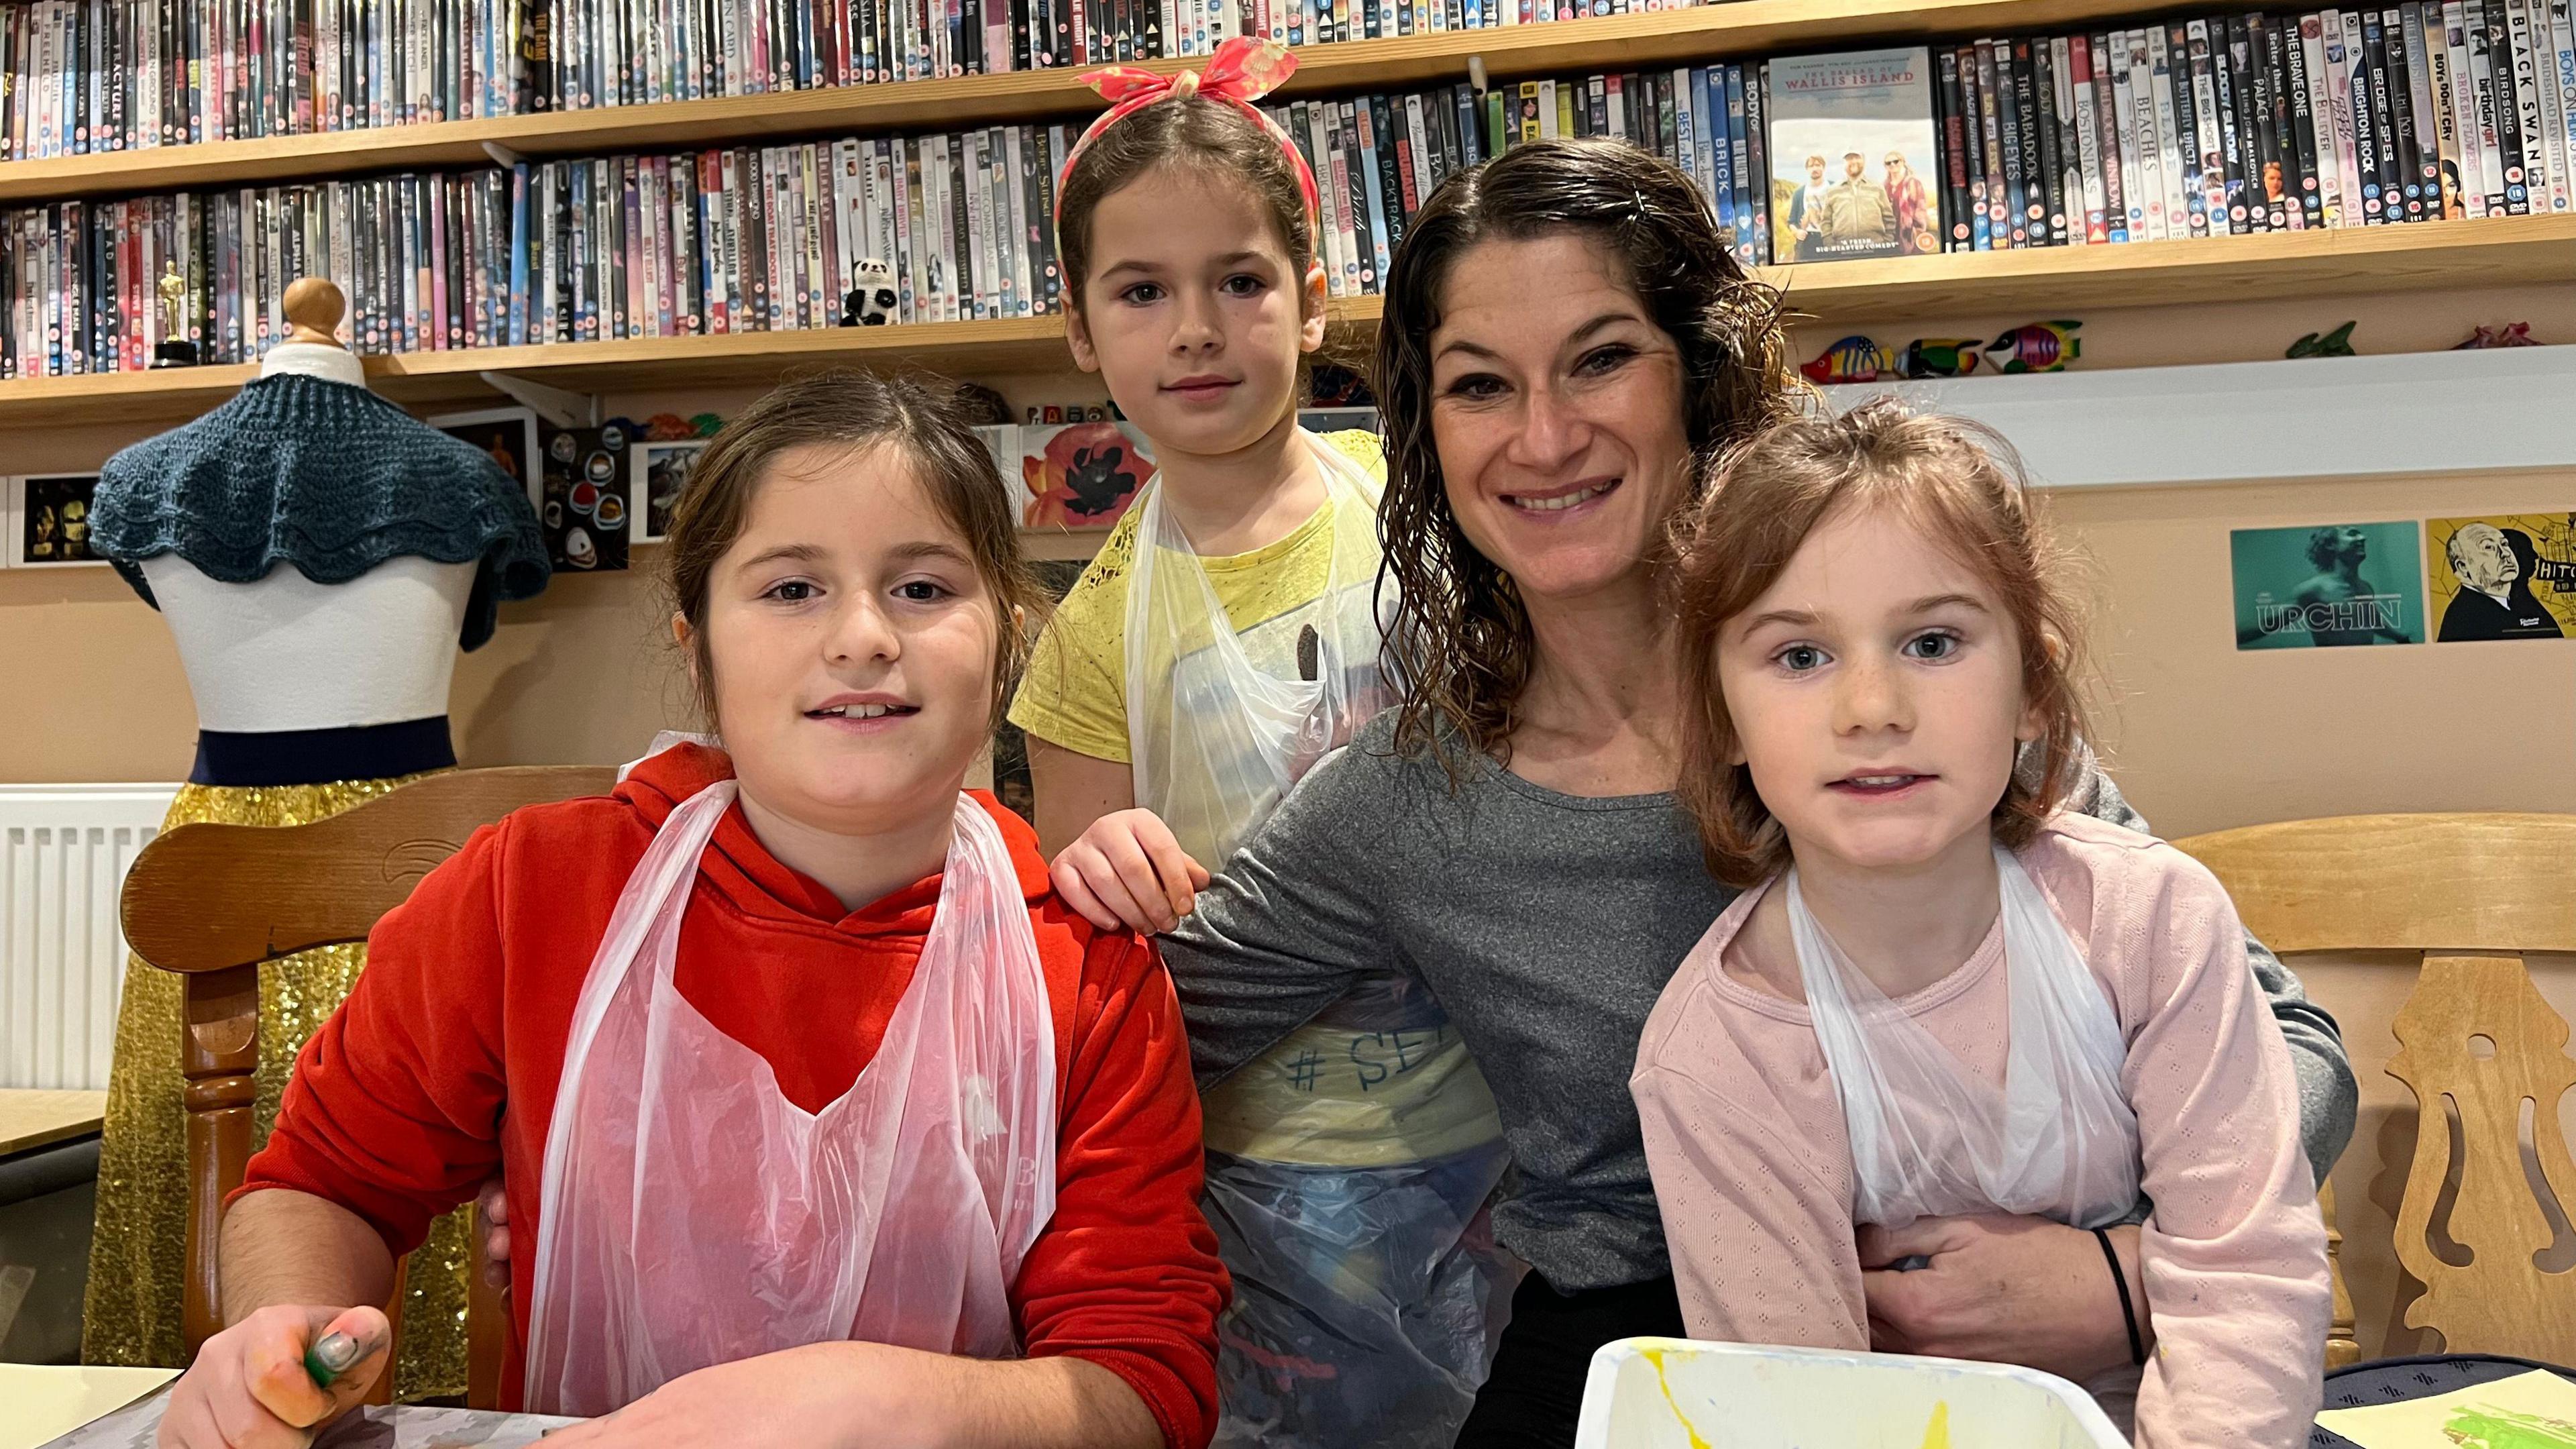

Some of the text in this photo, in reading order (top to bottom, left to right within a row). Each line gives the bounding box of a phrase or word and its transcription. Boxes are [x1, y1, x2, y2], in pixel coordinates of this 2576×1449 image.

[535, 13, 547, 60] THE GAME
[724, 20, 736, 58] CARD
[1073, 14, 1083, 46] BRIGHT
[2267, 32, 2279, 66] Better
[111, 44, 122, 119] FRACTURE
[148, 30, 157, 115] FROZEN GROUND
[1784, 72, 1915, 90] WALLIS ISLAND
[1830, 66, 1874, 76] BALLAD
[2272, 68, 2283, 93] than
[2286, 25, 2308, 118] THE BRAVE ONE
[2512, 16, 2542, 161] BLACK SWAN
[2558, 50, 2575, 85] BOYS
[1677, 111, 1691, 142] BEST
[1746, 80, 1760, 119] BODY
[1965, 84, 1980, 160] BLADE RUNNER
[2017, 74, 2038, 180] THE BABADOOK
[2038, 81, 2053, 115] BODY
[2178, 81, 2192, 127] BUTTERFLY
[2198, 77, 2214, 150] THE BIG SHORT
[2215, 54, 2238, 164] BLOODY SUNDAY
[2253, 78, 2269, 123] PALACE
[2312, 77, 2330, 152] THE BELIEVER
[2353, 76, 2375, 173] BRIGHTON ROCK
[2373, 68, 2387, 113] BRIDGE
[2380, 125, 2394, 162] SPIES
[2396, 92, 2412, 138] THE BOY
[2456, 72, 2477, 172] BROKEN FLOWERS
[2498, 67, 2514, 135] BIRDSONG
[2540, 52, 2563, 172] BRIDESHEAD REVISITED
[2563, 87, 2576, 111] ON
[1681, 153, 1693, 172] ME
[1697, 140, 1710, 163] Blue
[2002, 121, 2021, 181] BIG EYES
[2077, 99, 2098, 195] BOSTONIANS
[2100, 85, 2121, 209] BEDROOM WINDOW
[2136, 97, 2157, 172] BEACHES
[2159, 101, 2177, 171] BLADE
[2182, 131, 2194, 157] EFFECT
[2239, 88, 2259, 189] BEING JOHN MALKOVICH
[749, 152, 759, 181] BLOOD
[1036, 133, 1051, 217] Before Sunset
[1715, 137, 1729, 194] BRICK
[982, 186, 996, 271] BECOMING JANE
[1316, 164, 1336, 239] BRICK LANE
[1350, 171, 1366, 231] Birth
[1382, 160, 1402, 242] BACKTRACK
[292, 229, 301, 270] ALPHA
[767, 227, 775, 251] THAT
[808, 200, 819, 261] THE BLING RING
[996, 203, 1008, 260] BROOKLYN
[71, 270, 80, 306] SINGLE
[105, 240, 117, 326] AD ASTRA
[769, 252, 777, 286] ROCKED
[72, 307, 81, 331] MAN
[2255, 599, 2402, 635] URCHIN
